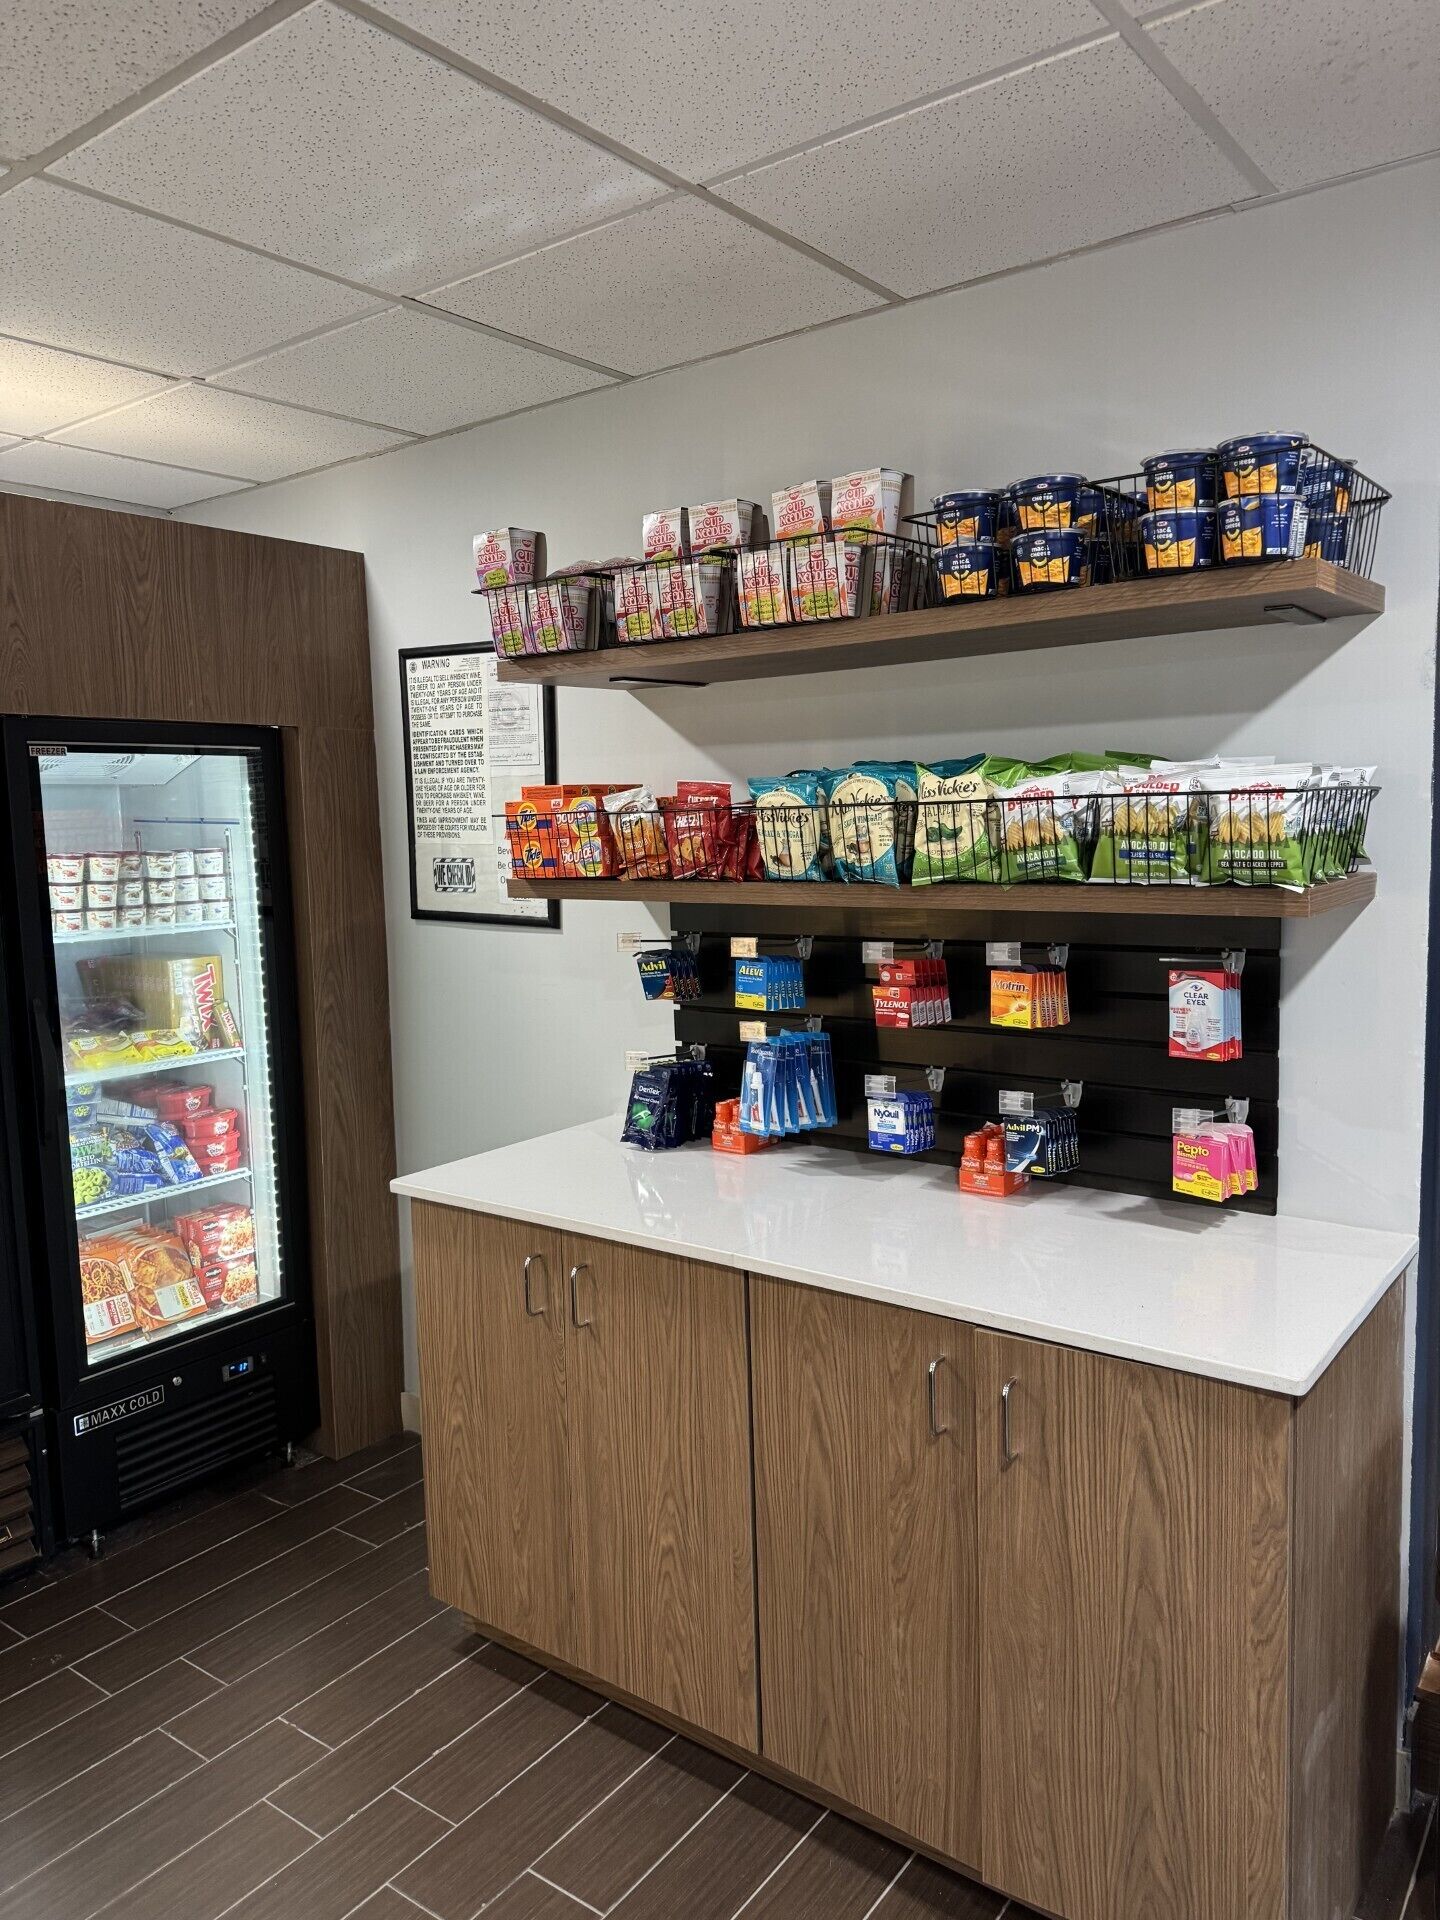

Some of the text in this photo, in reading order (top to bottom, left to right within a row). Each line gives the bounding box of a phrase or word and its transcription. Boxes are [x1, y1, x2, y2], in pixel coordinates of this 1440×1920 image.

[845, 486, 867, 501] CUP
[786, 499, 805, 514] CUP
[837, 494, 875, 513] NOODLES
[703, 515, 724, 528] CUP
[779, 507, 814, 527] NOODLES
[654, 524, 670, 536] CUP
[695, 523, 732, 540] NOODLES
[647, 531, 676, 547] NOODLES
[483, 543, 500, 554] CUP
[478, 550, 507, 566] NOODLES
[752, 565, 773, 579] CUP
[806, 559, 828, 572] CUP
[744, 573, 780, 589] NOODLES
[797, 568, 837, 584] NOODLES
[626, 585, 645, 597] CUP
[669, 580, 687, 591] CUP
[662, 589, 695, 603] NOODLES
[421, 658, 450, 670] WARNING
[412, 729, 446, 737] IDENTIFICATION
[412, 737, 428, 745] APPEAR
[440, 735, 469, 743] FRAUDULENT
[30, 747, 66, 756] FREEZER
[412, 744, 437, 752] PRESENTED
[443, 743, 473, 751] PURCHASERS
[427, 766, 459, 774] ENFORCEMENT
[937, 779, 979, 799] Vickie's
[525, 848, 541, 861] Tide
[562, 846, 595, 864] bounce
[1050, 847, 1063, 858] OL
[437, 864, 472, 886] WE CHECK ID
[641, 960, 667, 972] Advil
[739, 965, 764, 977] ALEVE
[992, 979, 1026, 992] Motrin
[192, 963, 218, 1033] TWIX
[1183, 991, 1209, 1000] CLEAR
[875, 998, 909, 1009] TYLENOL
[638, 1085, 660, 1096] DenTek
[874, 1108, 900, 1119] NyQuil
[1006, 1123, 1040, 1133] Advil PM
[1176, 1150, 1197, 1160] Bismol
[1177, 1141, 1210, 1157] Pepto
[91, 1390, 160, 1426] MAXX COLD
